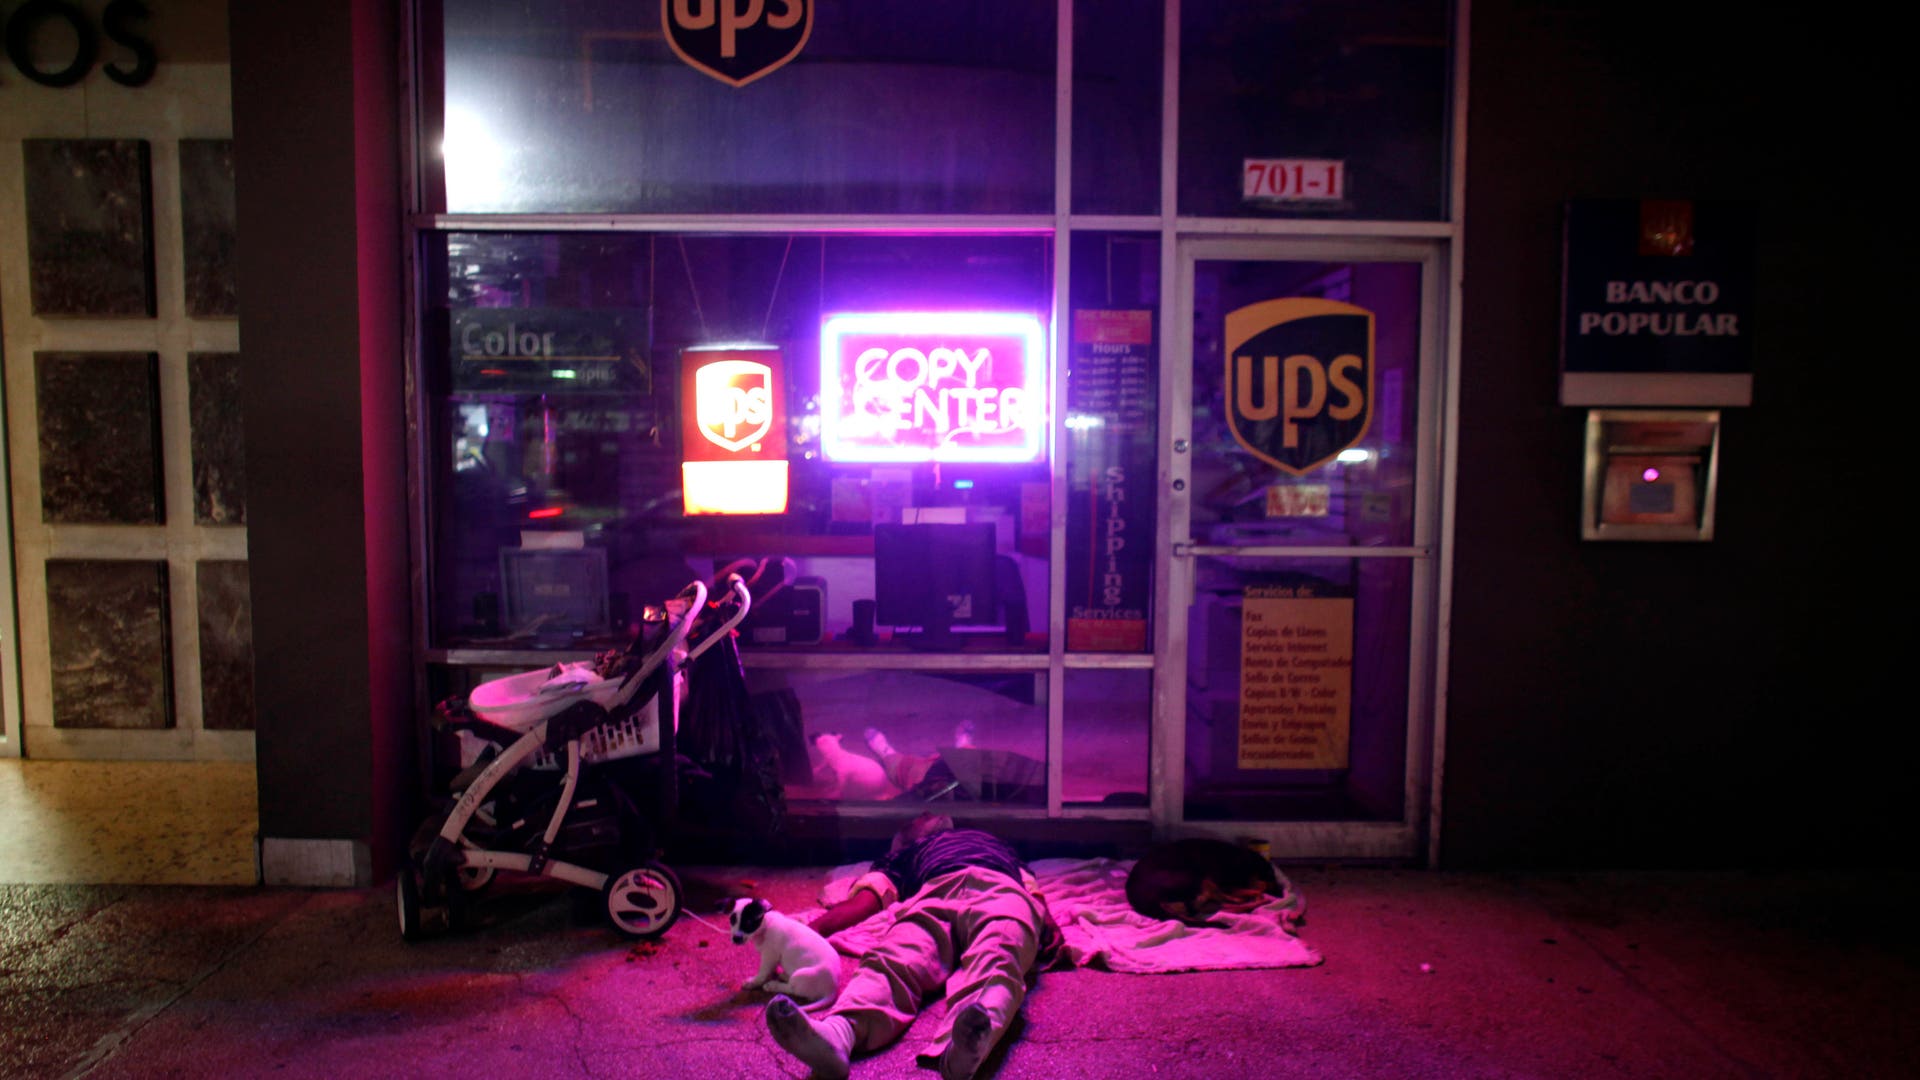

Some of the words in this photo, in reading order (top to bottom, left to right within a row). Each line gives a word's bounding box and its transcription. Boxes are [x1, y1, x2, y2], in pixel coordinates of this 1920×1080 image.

[1247, 163, 1339, 196] 701-1
[1605, 280, 1719, 304] BANCO
[1579, 312, 1739, 335] POPULAR
[461, 321, 555, 356] Color
[1092, 343, 1131, 354] Hours
[855, 347, 990, 389] COPY
[1237, 354, 1363, 448] ups
[704, 387, 767, 438] ps
[854, 387, 1026, 434] CENTER
[1104, 466, 1126, 606] Shipping
[1073, 606, 1142, 619] Services
[1246, 611, 1262, 621] Fax
[1246, 626, 1277, 639] Copias
[1281, 627, 1293, 637] de
[1296, 626, 1327, 637] Llaves
[1246, 642, 1283, 652] Servicio
[1287, 642, 1328, 652] Internet
[1245, 657, 1273, 668] Renta
[1277, 657, 1288, 667] de
[1245, 672, 1269, 682] Sello
[1271, 672, 1283, 682] de
[1287, 672, 1321, 683] Correo
[1245, 688, 1276, 701] Copias
[1311, 687, 1336, 698] Color
[1243, 704, 1294, 715] Apartados
[1297, 704, 1336, 715] Postales
[1242, 734, 1270, 744] Sellos
[1273, 734, 1285, 744] de
